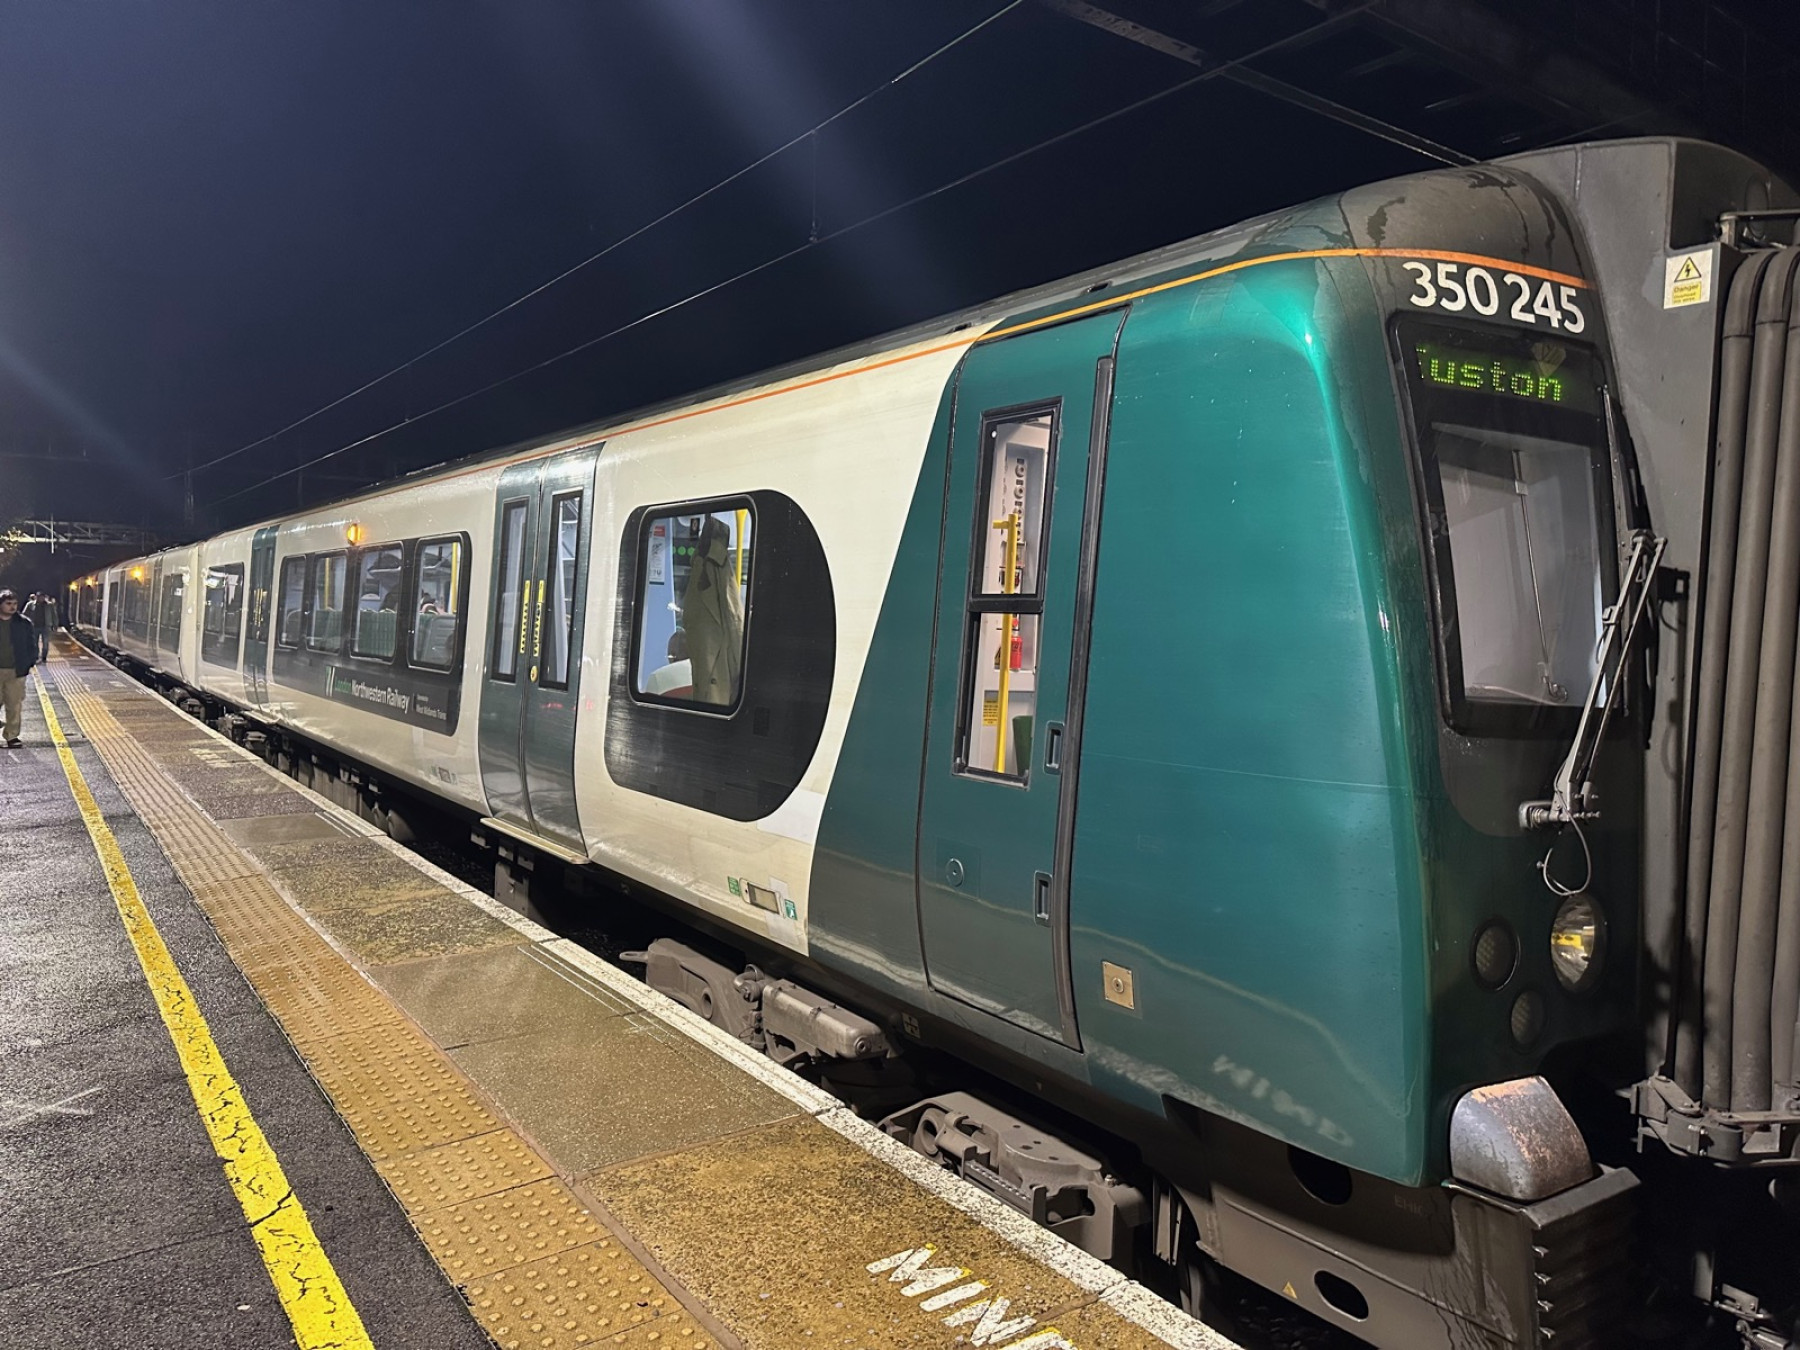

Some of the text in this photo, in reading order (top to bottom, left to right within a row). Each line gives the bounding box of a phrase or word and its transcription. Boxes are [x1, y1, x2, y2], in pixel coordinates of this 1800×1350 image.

[1402, 261, 1585, 334] 350 245
[352, 680, 387, 704] Northwestern
[387, 687, 410, 714] Railway
